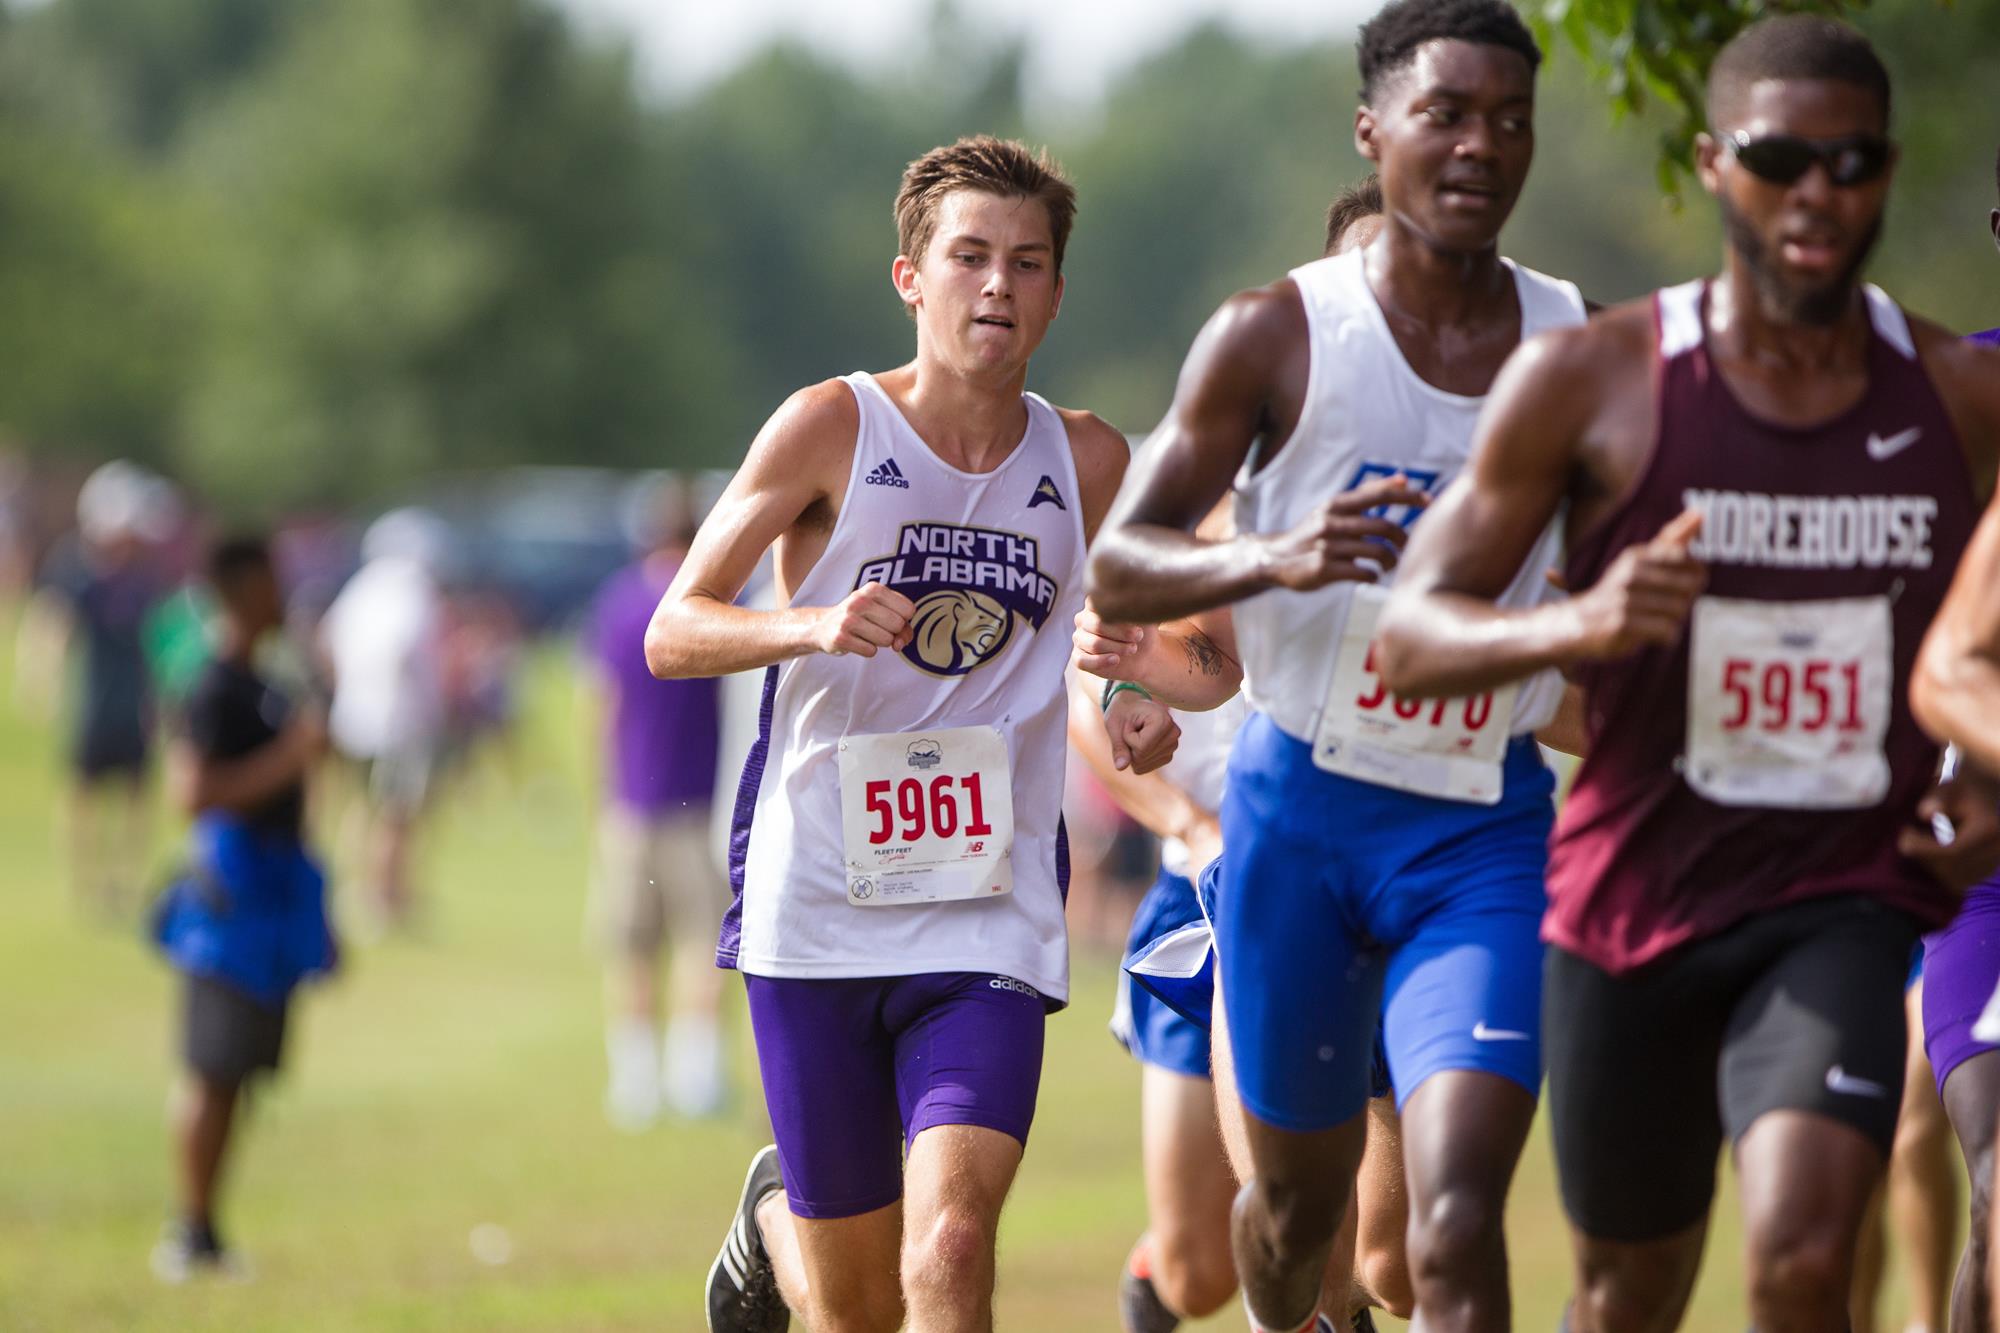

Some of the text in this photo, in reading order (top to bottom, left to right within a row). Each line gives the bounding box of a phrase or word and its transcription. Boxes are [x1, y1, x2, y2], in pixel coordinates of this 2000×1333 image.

[865, 474, 910, 489] adidas
[900, 526, 1035, 568] NORTH
[1682, 488, 1938, 568] MOREHOUSE
[858, 556, 1057, 614] ALABAMA
[1720, 659, 1866, 734] 5951
[865, 772, 992, 845] 5961
[874, 848, 895, 856] FLEET
[989, 979, 1038, 999] adidas
